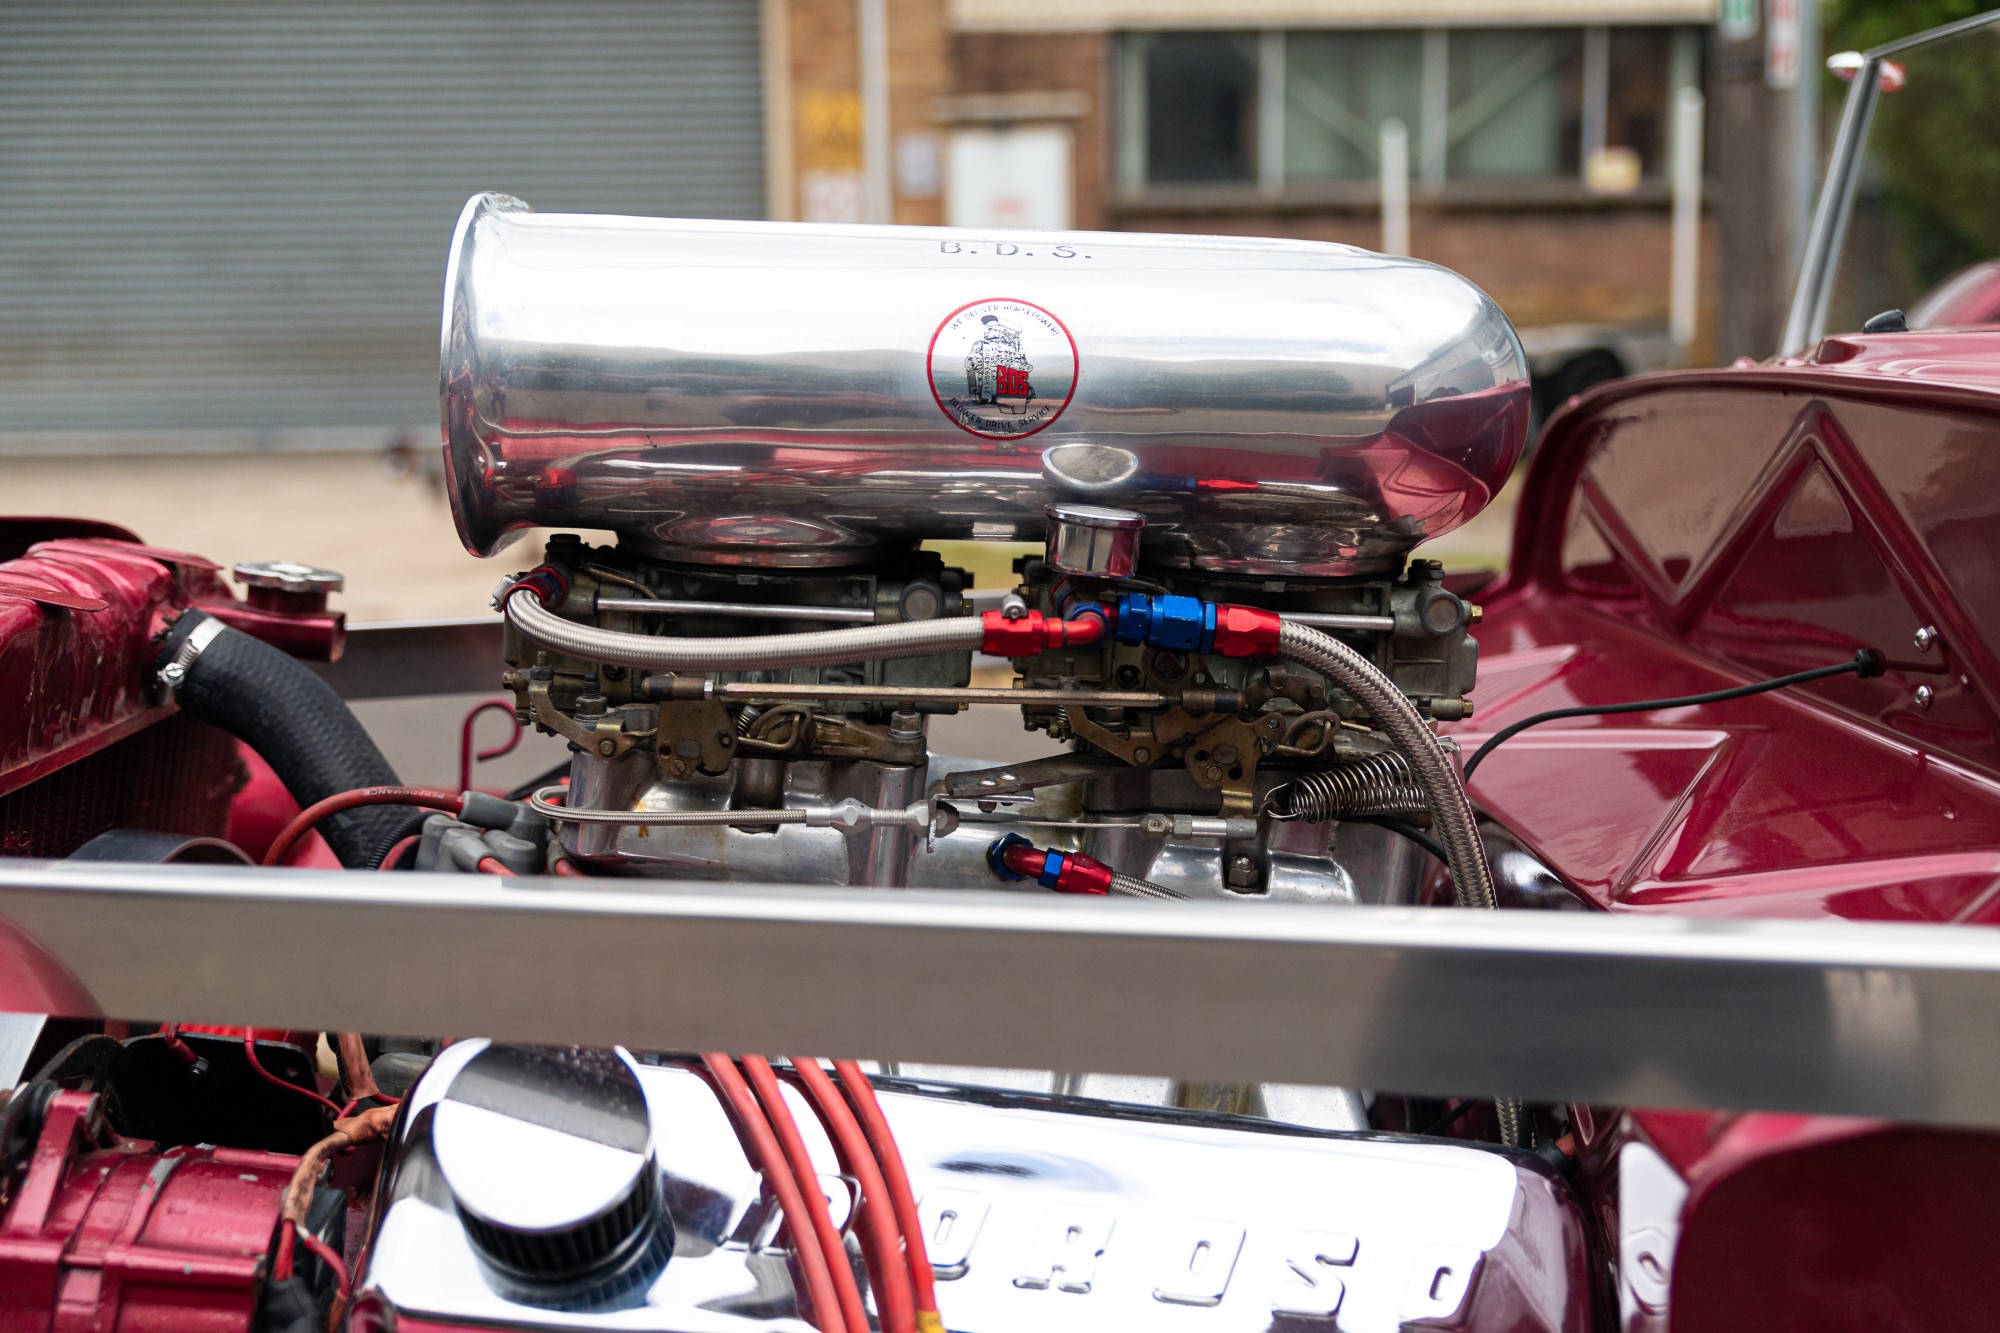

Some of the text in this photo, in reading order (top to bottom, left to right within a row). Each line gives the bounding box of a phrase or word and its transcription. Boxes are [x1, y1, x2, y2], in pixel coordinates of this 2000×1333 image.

[965, 305, 999, 320] DELIVER
[997, 365, 1030, 397] BDS
[949, 397, 1052, 429] BLOWER DRIVE SERVICE
[362, 787, 445, 799] PERFORMANCE
